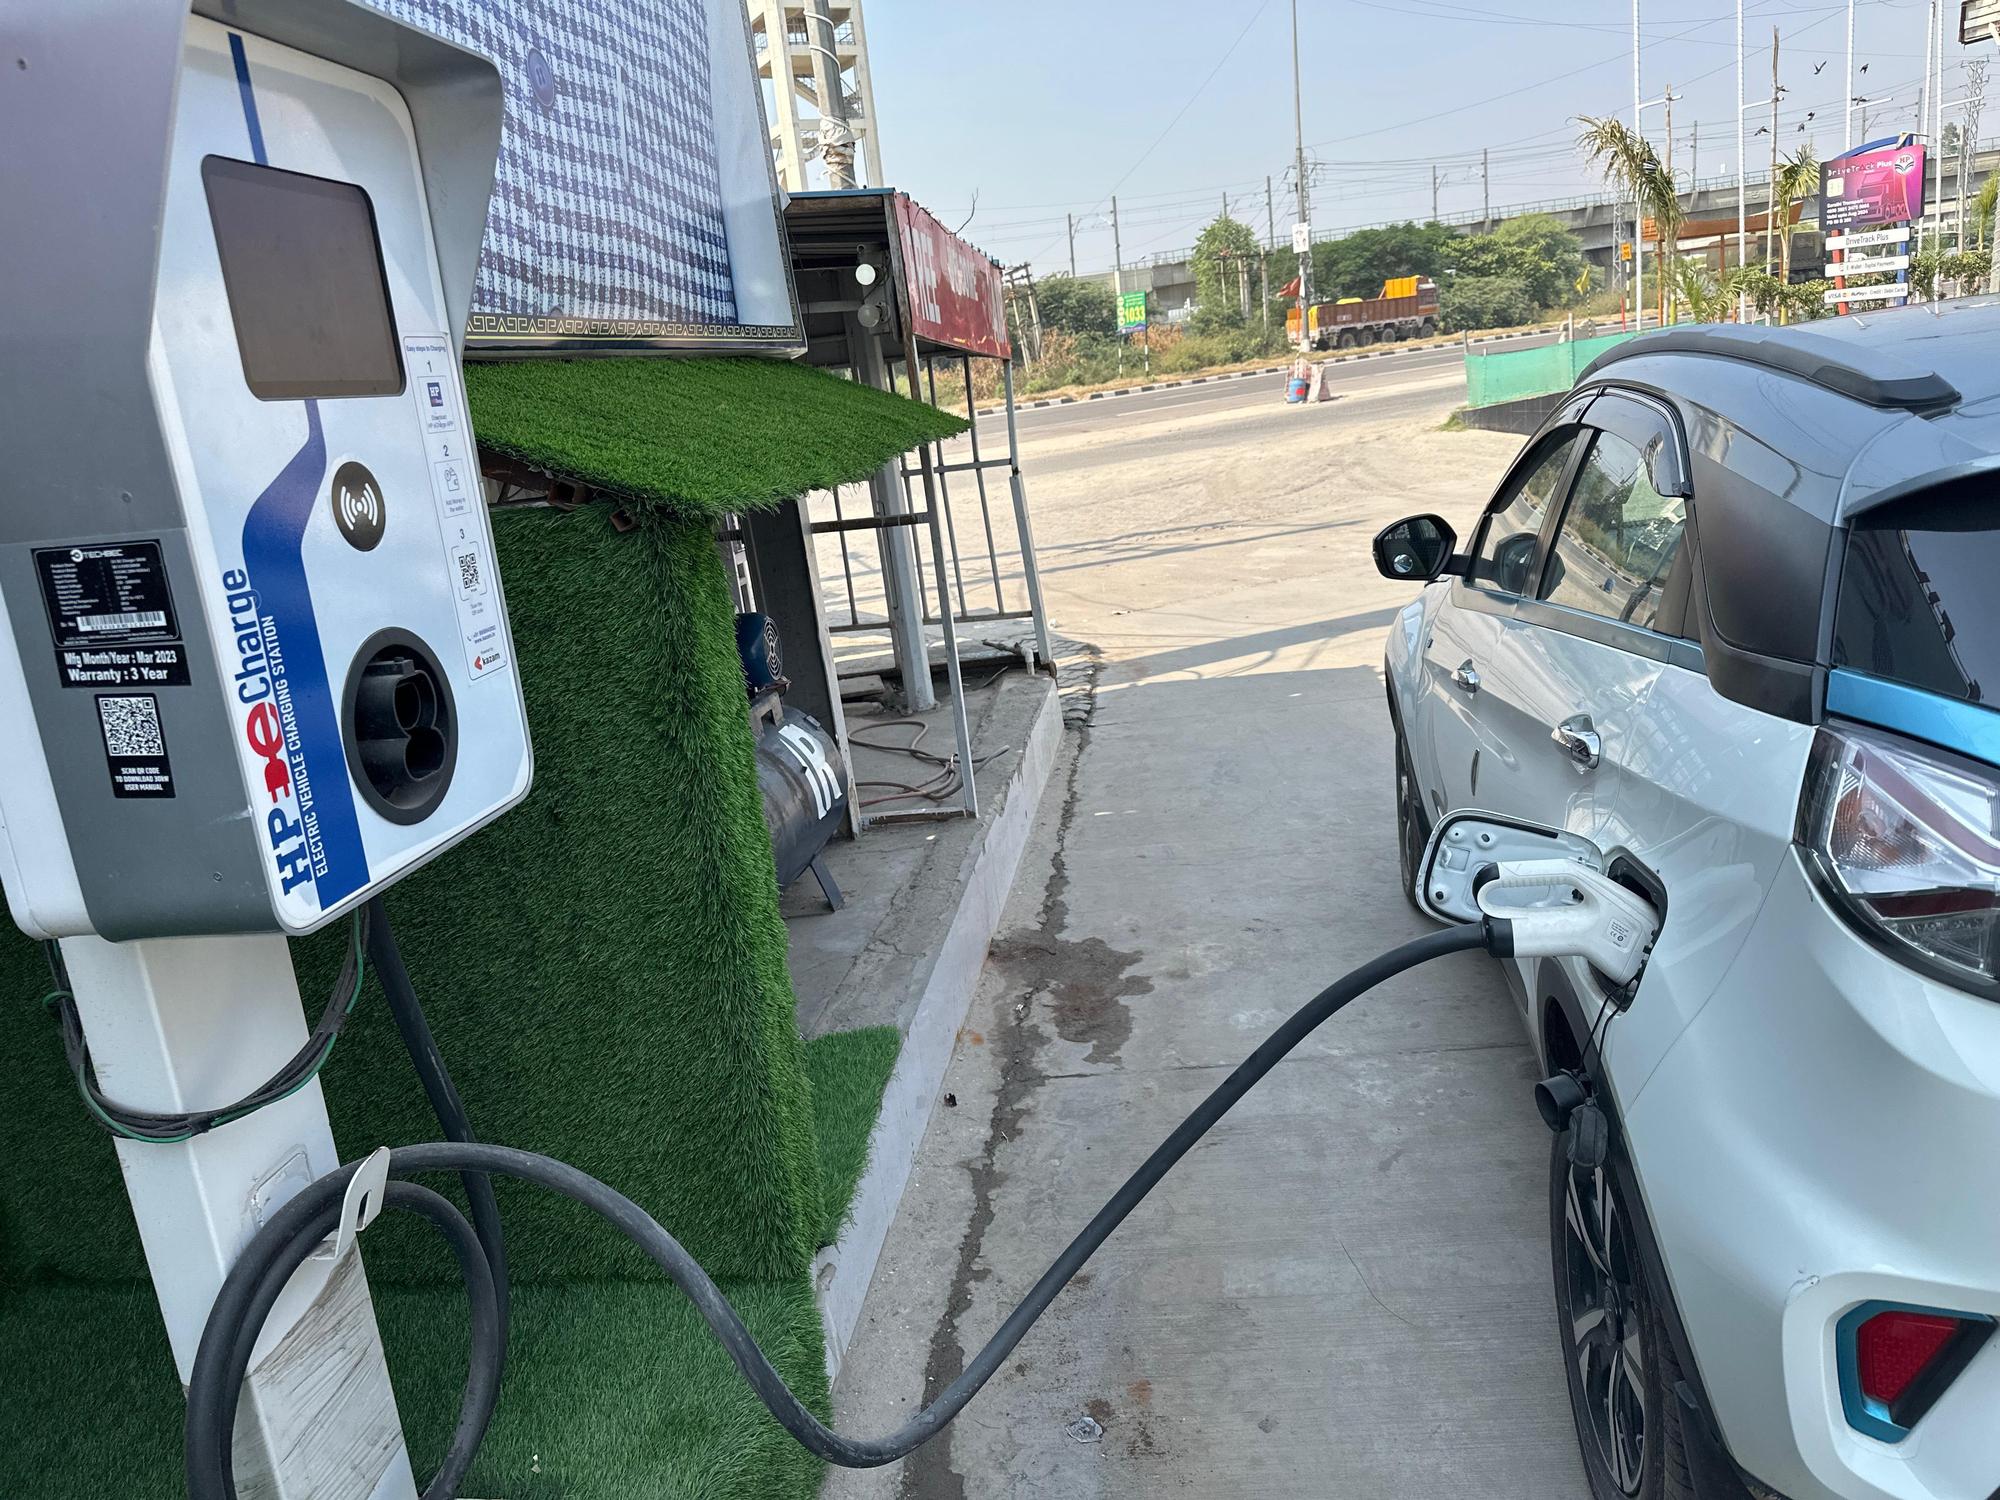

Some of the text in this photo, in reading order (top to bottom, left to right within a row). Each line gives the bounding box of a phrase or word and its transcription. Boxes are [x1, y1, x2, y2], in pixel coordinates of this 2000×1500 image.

[1876, 160, 1892, 168] Plus
[1845, 233, 1889, 246] DriveTrack Plus
[1125, 304, 1146, 323] 1033
[427, 360, 433, 373] 1
[430, 386, 440, 397] HP
[443, 444, 450, 457] 2
[459, 528, 466, 540] 3
[64, 651, 82, 668] Mfg
[82, 650, 130, 665] Month/Year
[136, 650, 154, 664] Mar
[154, 650, 178, 664] 2023
[482, 652, 501, 666] kazam
[67, 667, 122, 684] Warranty
[130, 667, 139, 680] 3
[140, 667, 168, 680] Year
[261, 616, 330, 878] ELECTRIC VEHICLE CHARGING STATION
[121, 767, 137, 775] SCAN
[145, 767, 160, 775] CODE
[115, 775, 123, 783] TO
[124, 783, 164, 791] USER MANUAL
[267, 807, 315, 897] HP
